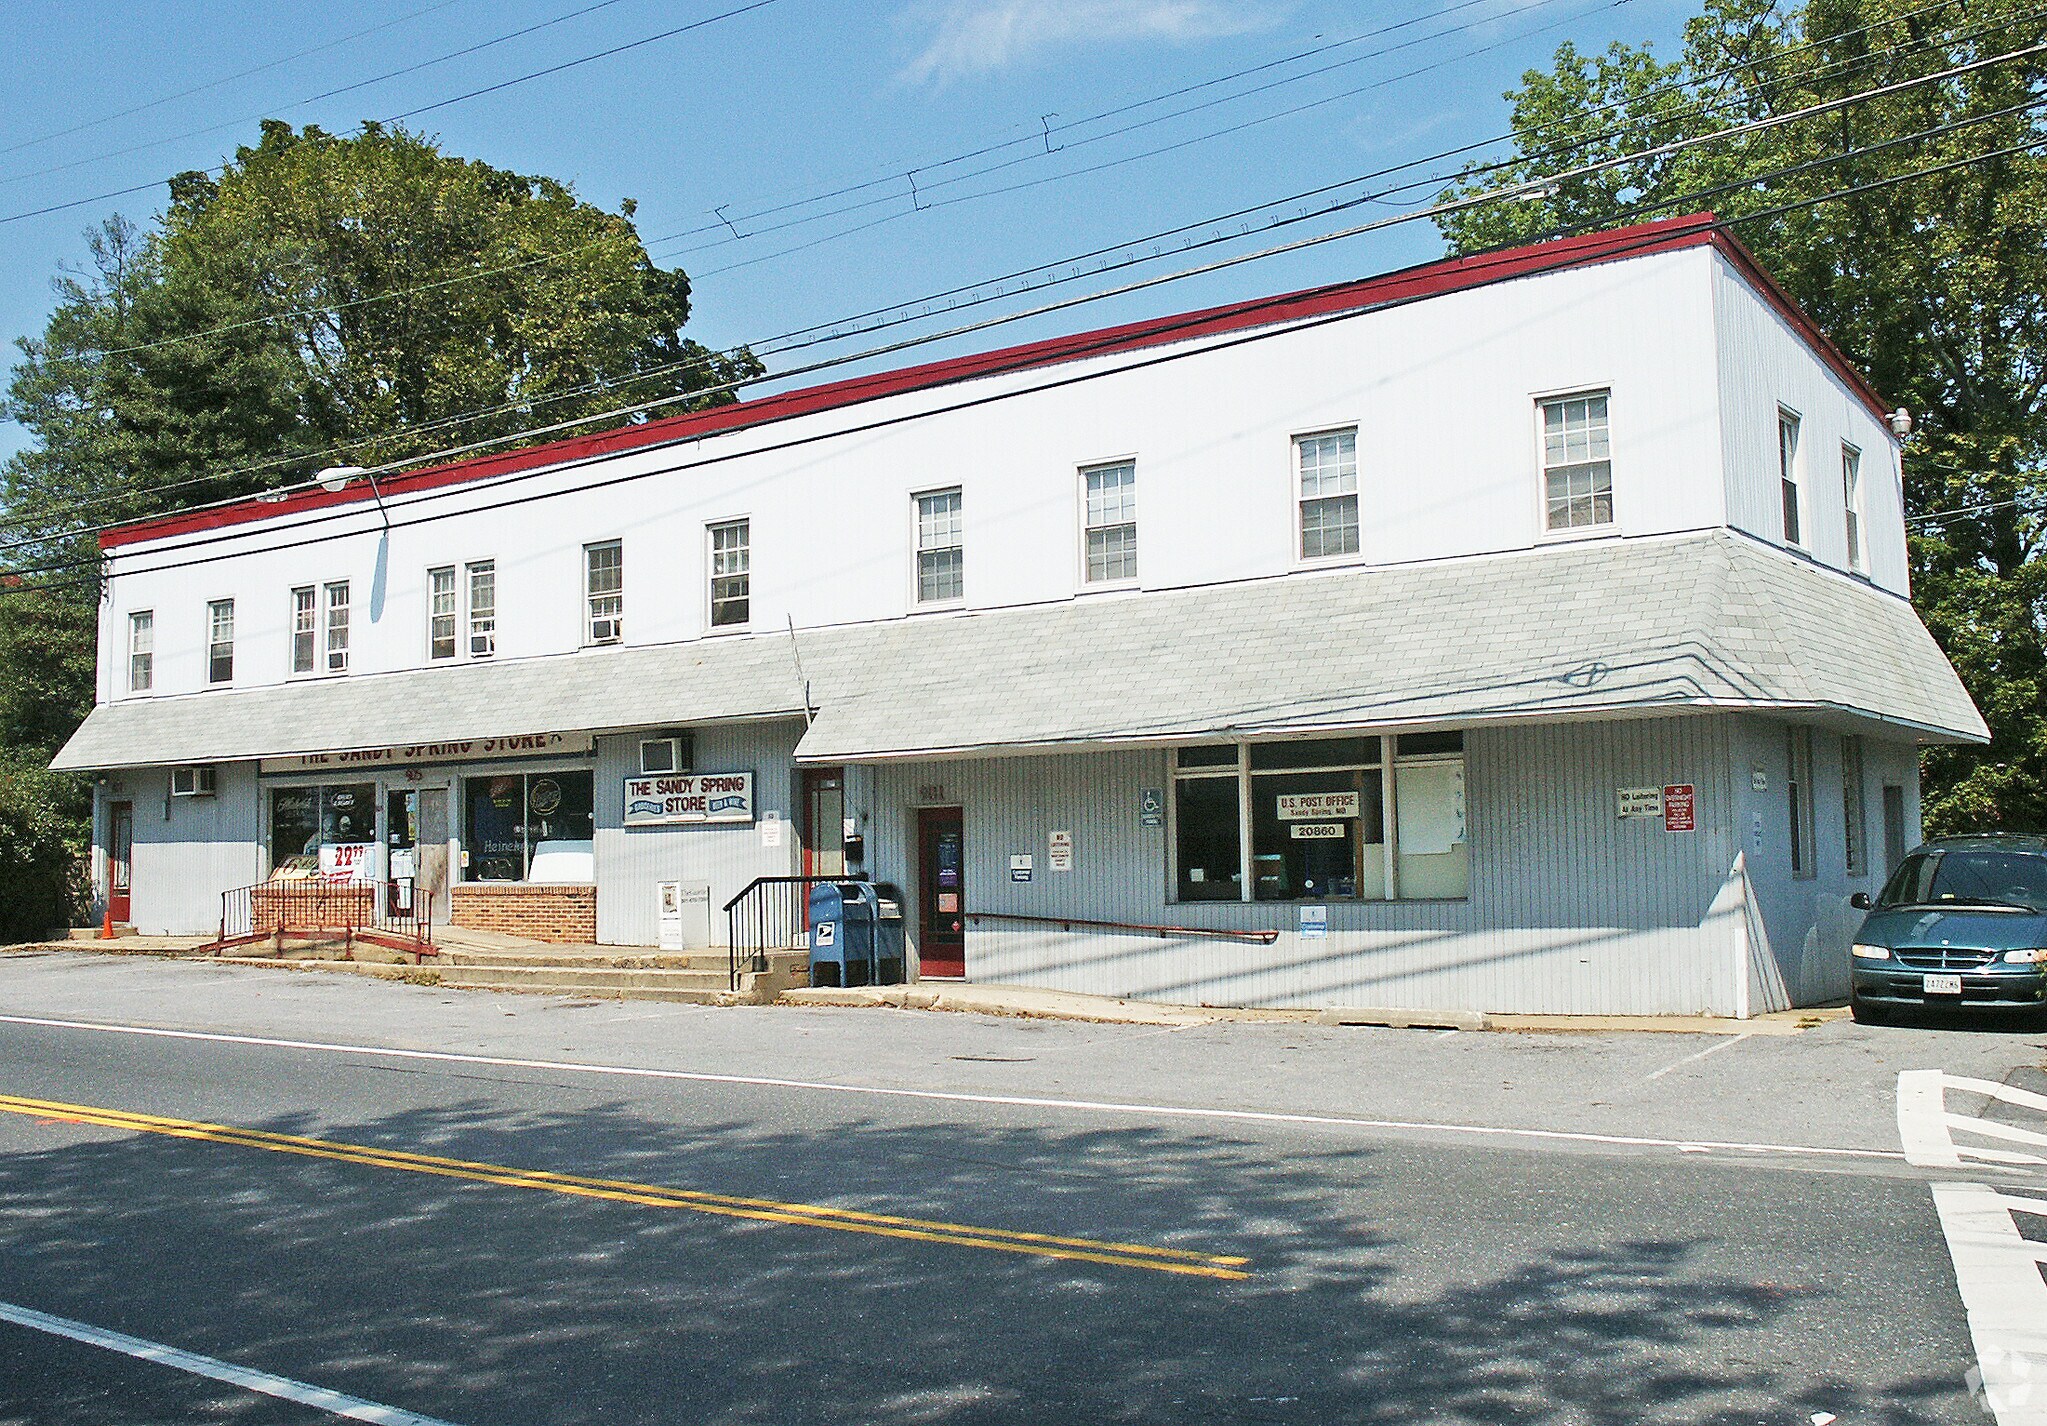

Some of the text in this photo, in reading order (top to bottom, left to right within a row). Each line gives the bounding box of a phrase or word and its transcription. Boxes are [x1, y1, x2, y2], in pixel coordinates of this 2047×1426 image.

[484, 735, 547, 751] STORE
[629, 776, 745, 796] THE SANDY SPRING
[665, 796, 706, 812] STORE
[1281, 795, 1355, 808] U.S. POST OFFICE
[1298, 826, 1336, 836] 20860
